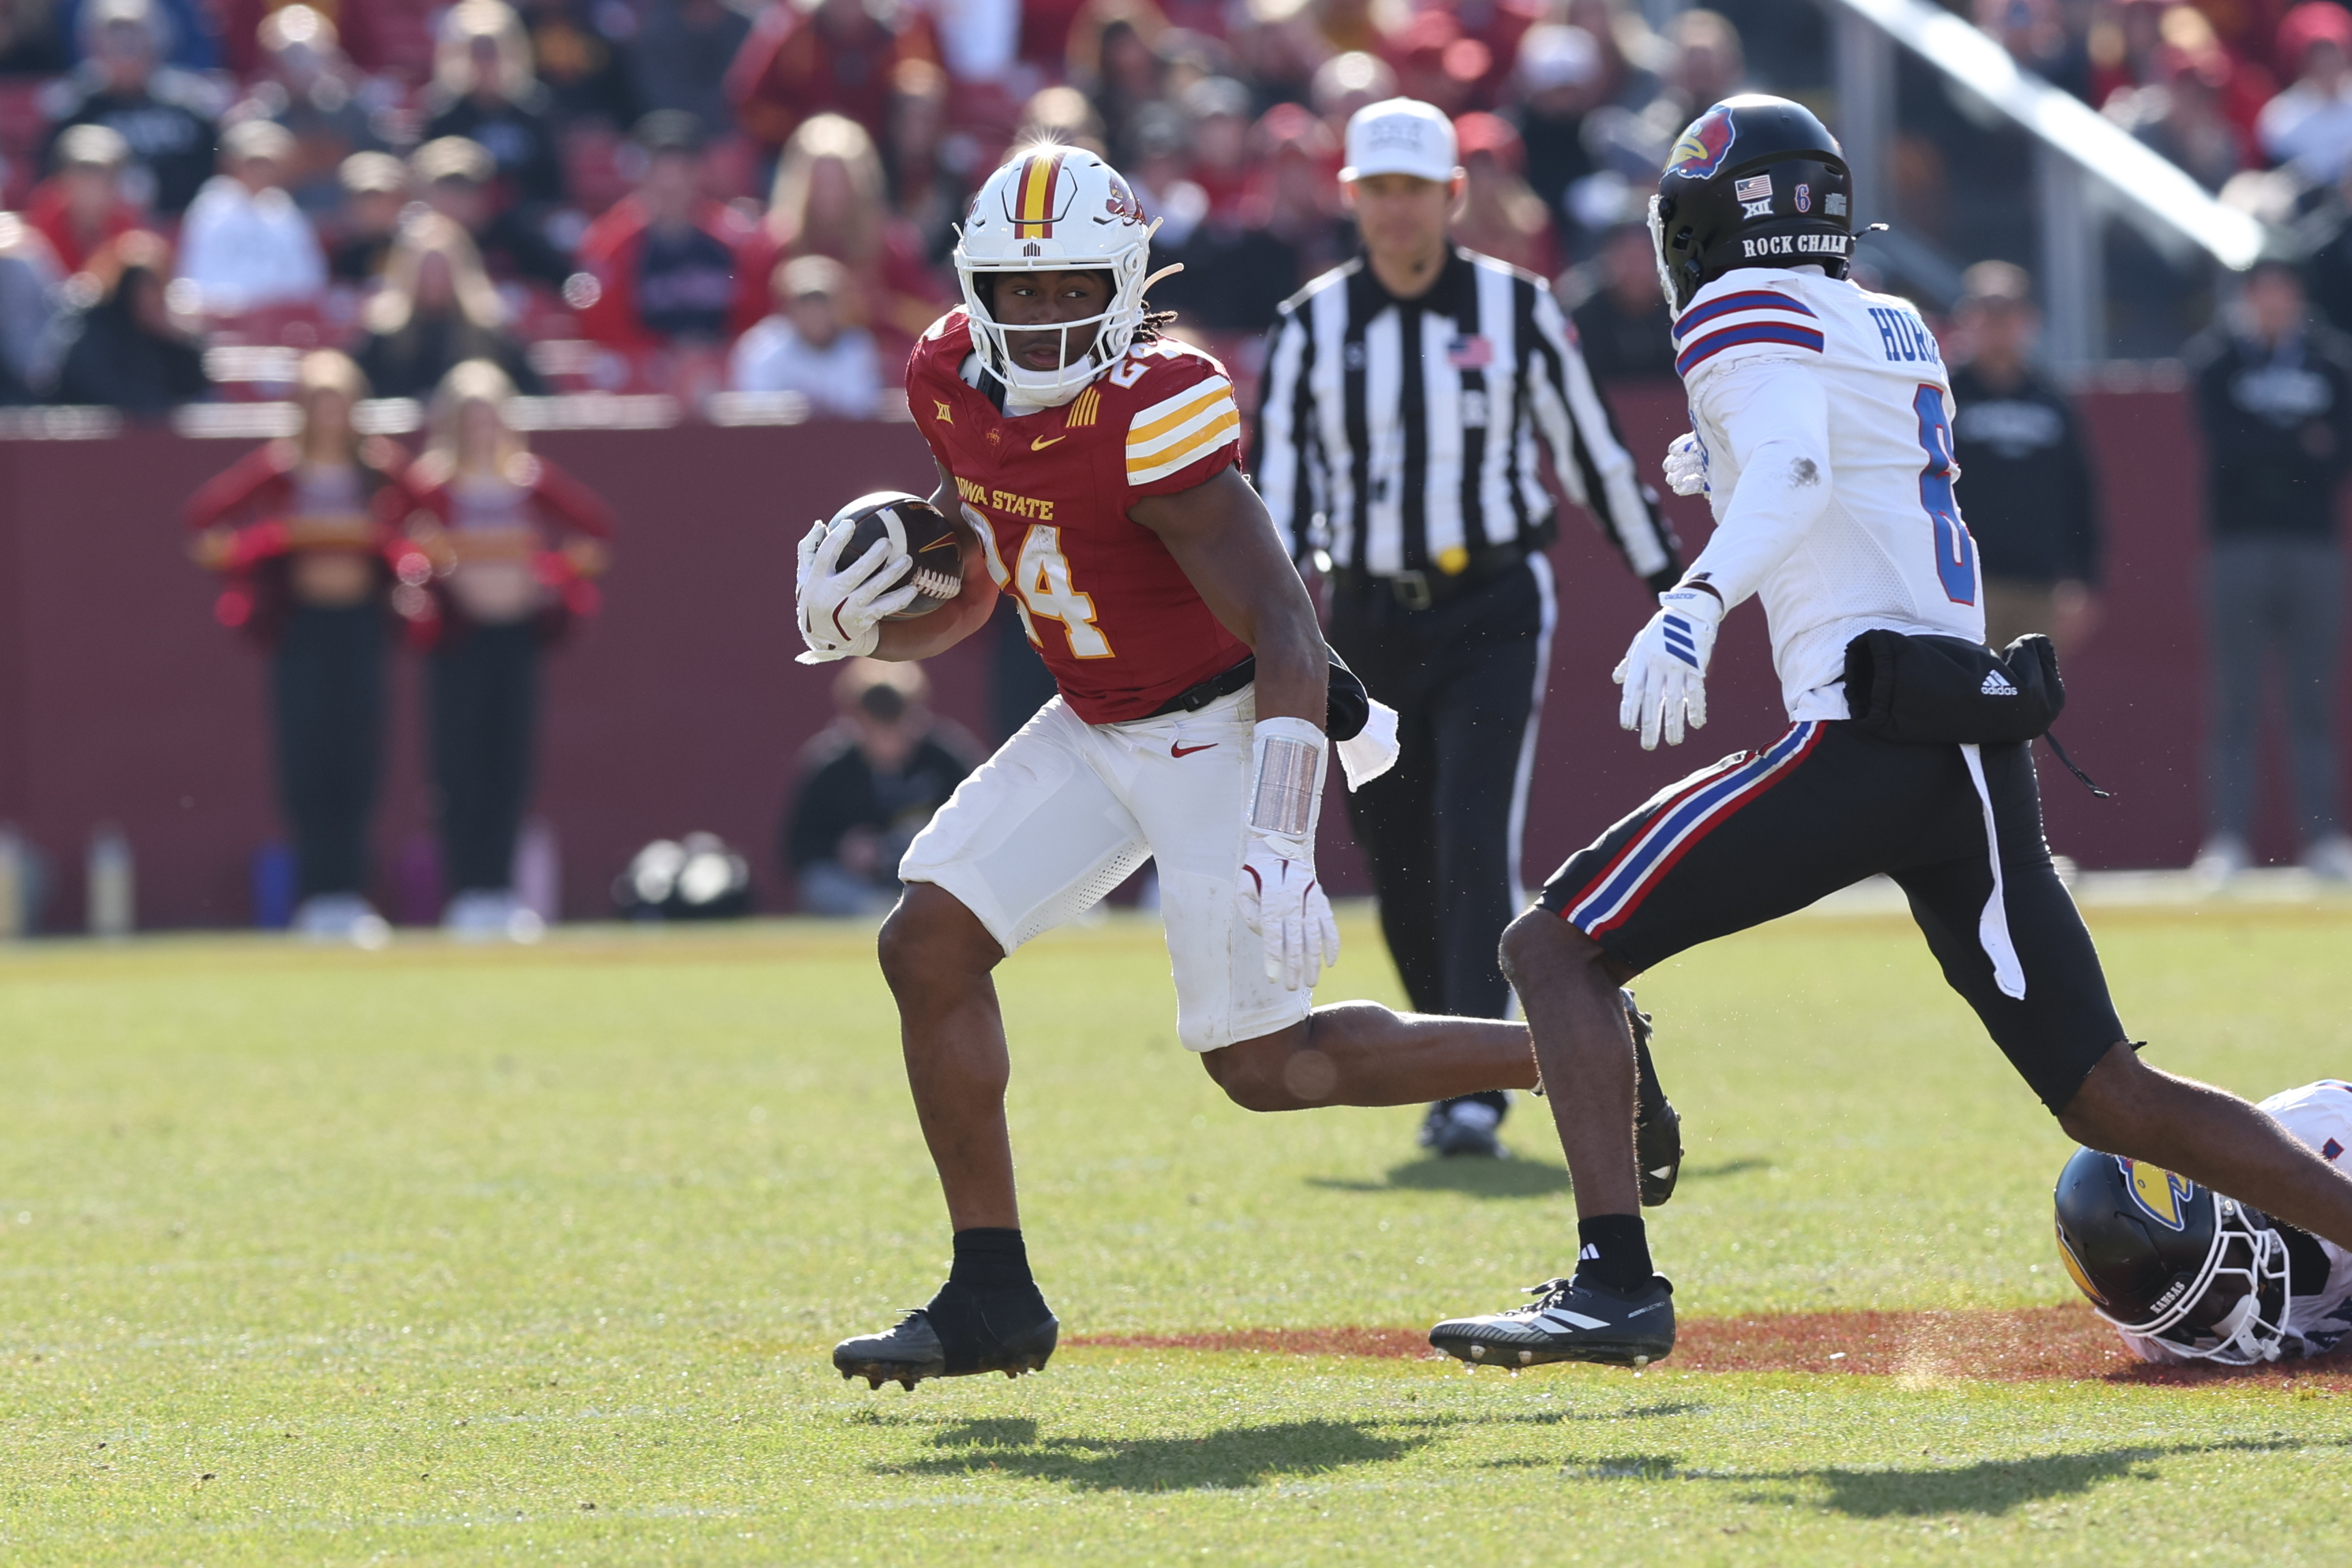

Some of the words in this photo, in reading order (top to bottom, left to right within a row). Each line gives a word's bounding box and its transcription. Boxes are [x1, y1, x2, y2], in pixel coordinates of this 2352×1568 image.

[1795, 183, 1811, 213] 6
[1742, 235, 1793, 257] ROCK
[1797, 234, 1848, 253] CHALK
[992, 490, 1054, 520] STATE
[1981, 686, 2018, 695] adidas
[2150, 1281, 2186, 1314] KANSAS
